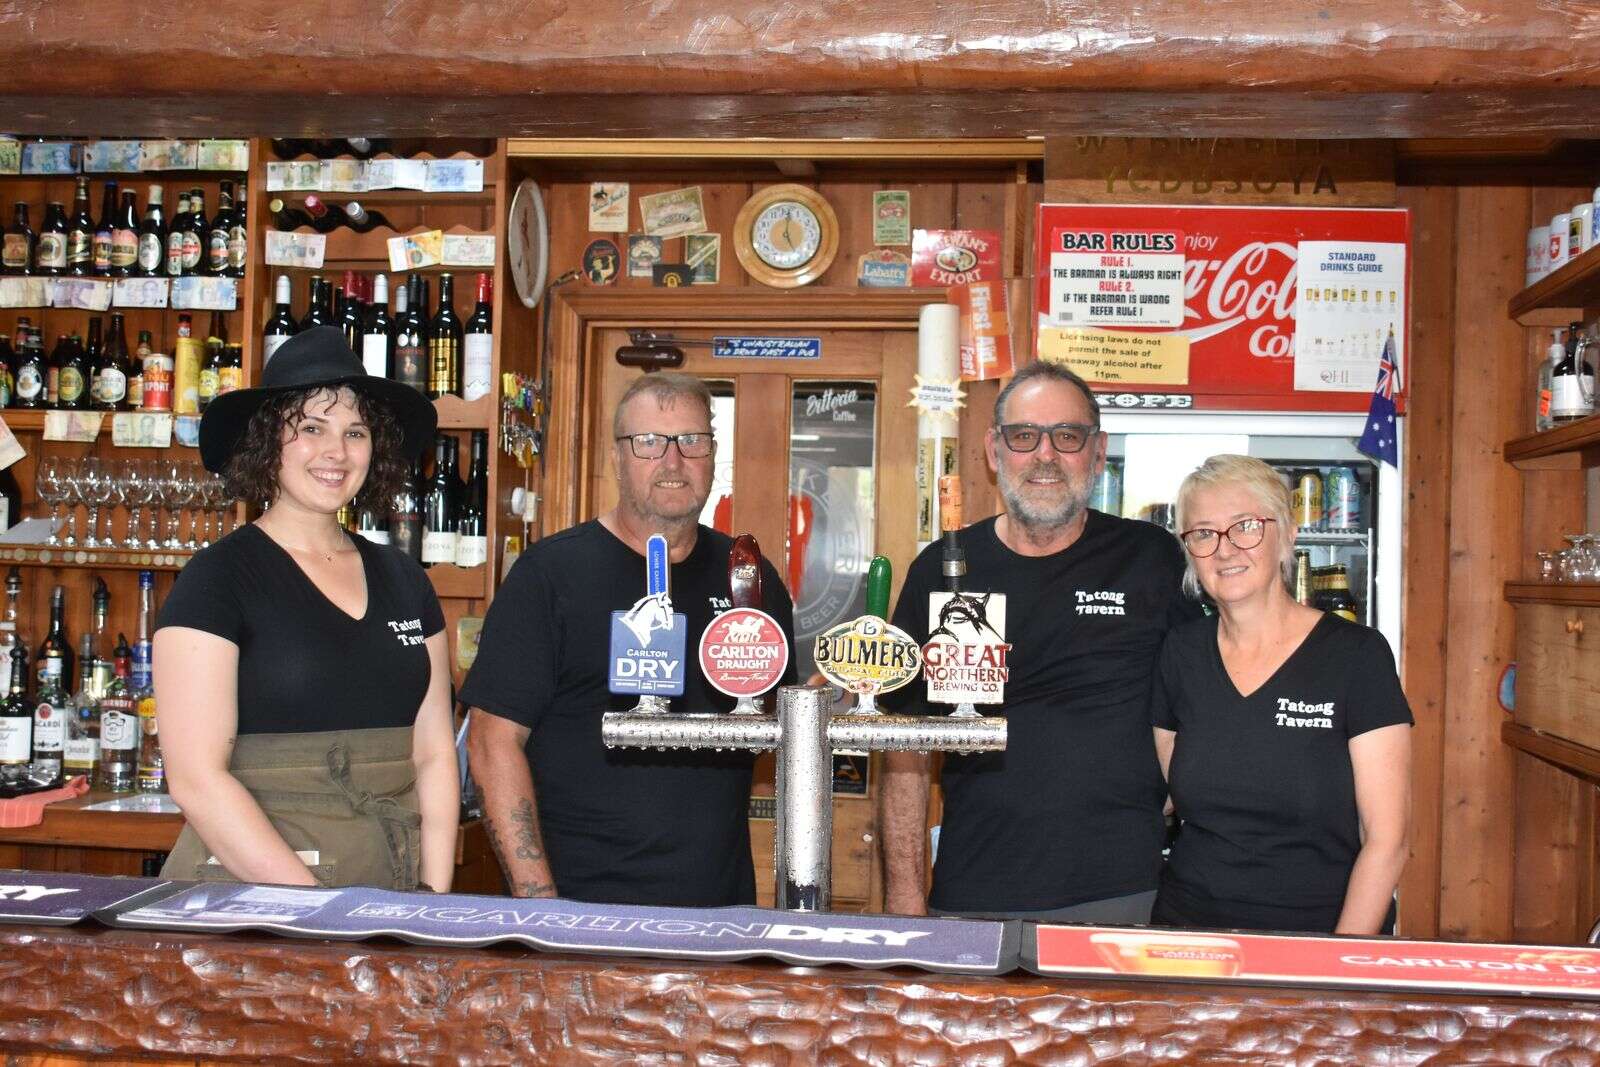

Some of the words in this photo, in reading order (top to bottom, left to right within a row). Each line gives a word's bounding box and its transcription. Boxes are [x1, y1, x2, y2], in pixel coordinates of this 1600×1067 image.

[1062, 231, 1106, 251] BAR
[1111, 232, 1176, 252] RULES
[1183, 232, 1218, 251] njoy
[1100, 256, 1124, 267] RULE
[1328, 252, 1376, 262] STANDARD
[1320, 262, 1354, 272] DRINKS
[1357, 263, 1384, 273] GUIDE
[929, 268, 981, 285] EXPORT
[1053, 268, 1067, 278] THE
[1070, 268, 1106, 279] BARMAN
[1109, 269, 1117, 279] IS
[1119, 270, 1154, 280] ALWAYS
[1156, 270, 1182, 280] RIGHT
[1099, 281, 1123, 291] RULE
[1063, 293, 1071, 303] IF
[1073, 293, 1088, 303] THE
[1090, 294, 1126, 304] BARMAN
[1128, 294, 1137, 304] IS
[1139, 294, 1170, 304] WRONG
[1090, 305, 1114, 316] REFER
[1116, 306, 1137, 316] RULE
[1107, 335, 1129, 344] laws
[1131, 337, 1143, 345] do
[1146, 338, 1162, 346] not
[717, 348, 731, 356] TO
[760, 348, 784, 356] PAST
[798, 348, 815, 357] PUB
[1101, 346, 1117, 355] the
[1119, 348, 1139, 356] sale
[1141, 349, 1152, 357] of
[1103, 359, 1137, 368] alcohol
[1139, 361, 1162, 370] after
[832, 410, 856, 422] Coffee
[709, 597, 731, 608] Tat
[1075, 590, 1125, 604] Tatong
[801, 595, 841, 630] BEER
[1075, 604, 1125, 616] Tavern
[708, 644, 779, 660] CARLTON
[815, 633, 919, 669] BULMERS
[920, 641, 1013, 669] GREAT
[616, 657, 679, 679] DRY
[716, 659, 771, 670] DRAUGHT
[923, 664, 1010, 683] NORTHERN
[933, 681, 978, 692] BREWING
[981, 683, 1000, 693] CO.
[1276, 697, 1335, 715] Tatong
[1275, 713, 1334, 728] Tavern
[419, 906, 770, 939] CARLTON
[766, 923, 934, 946] DRY
[1339, 955, 1549, 973] CARLTON
